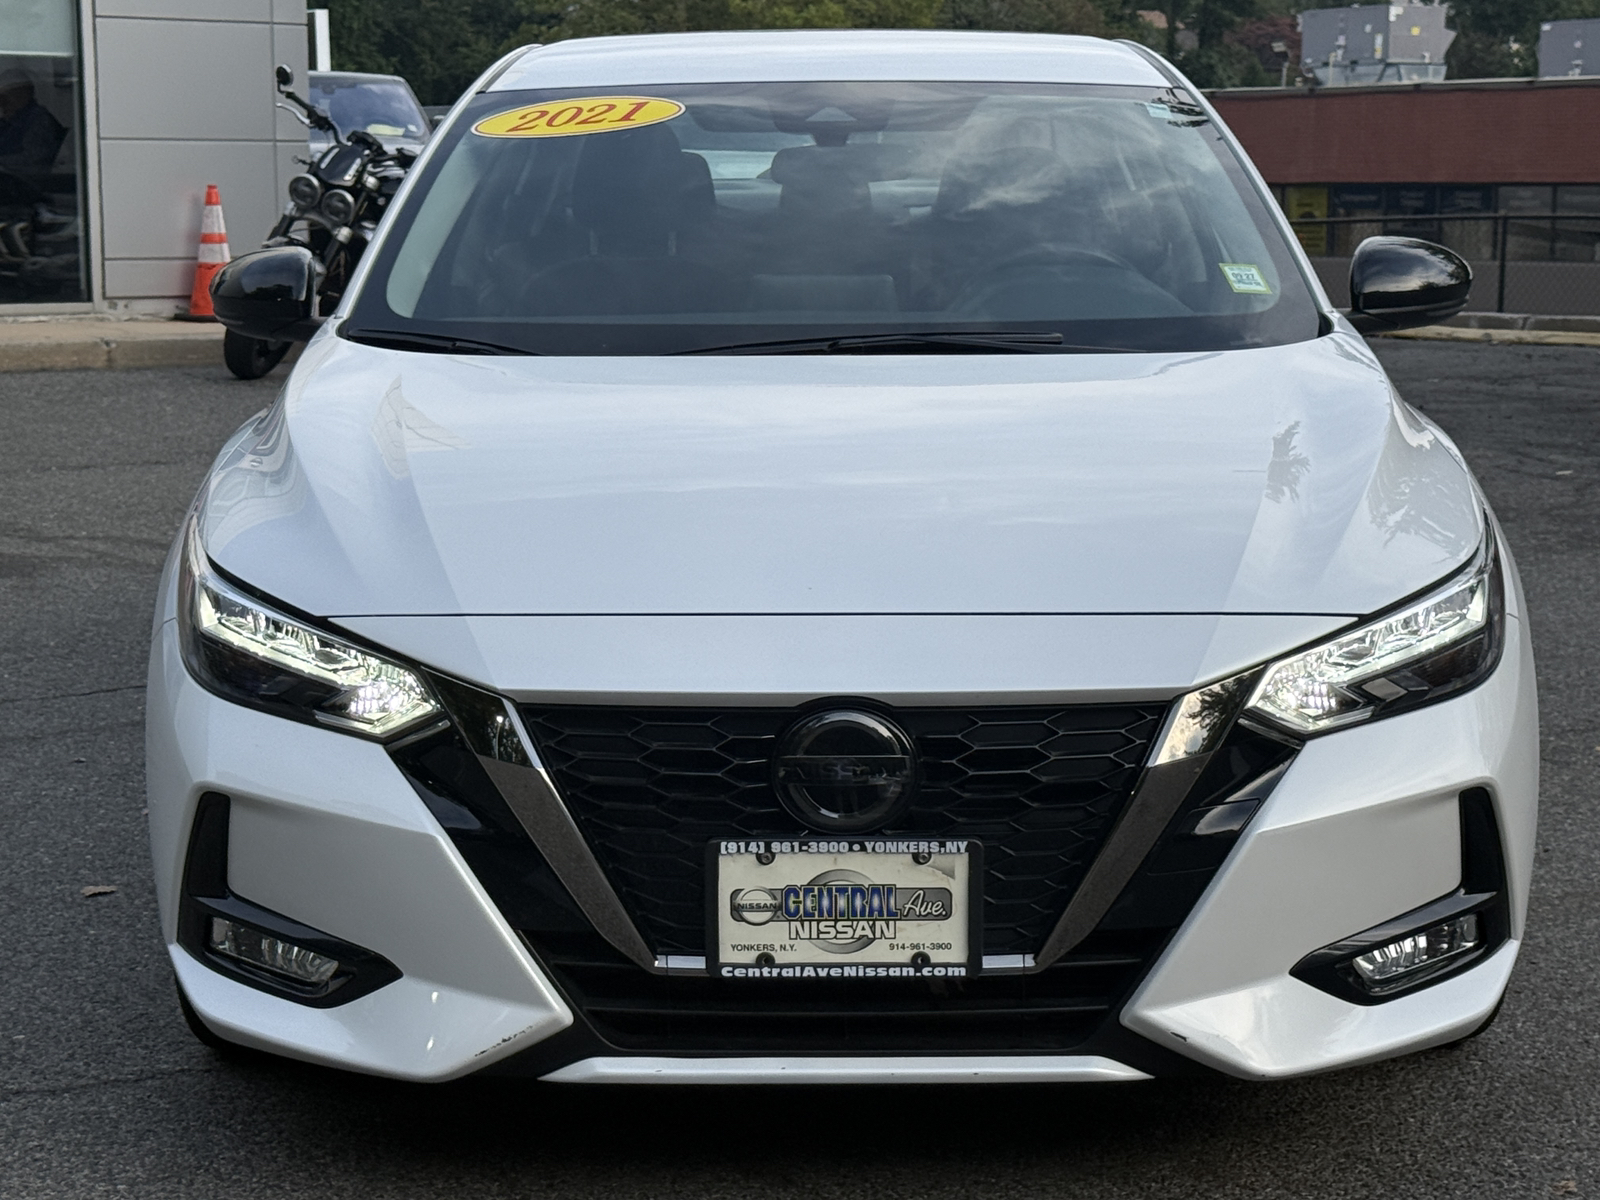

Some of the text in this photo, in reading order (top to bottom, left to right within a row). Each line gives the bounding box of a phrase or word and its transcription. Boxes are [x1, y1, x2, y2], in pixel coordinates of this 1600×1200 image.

[505, 101, 649, 132] 2021
[771, 841, 848, 853] 961-3900
[865, 841, 967, 854] YONKERS,NY
[782, 884, 947, 920] CENTRAL Ave.
[789, 921, 896, 940] NISSAN
[730, 943, 797, 952] YONKERS, N.Y.
[720, 965, 967, 977] CentralAveNissan.com
